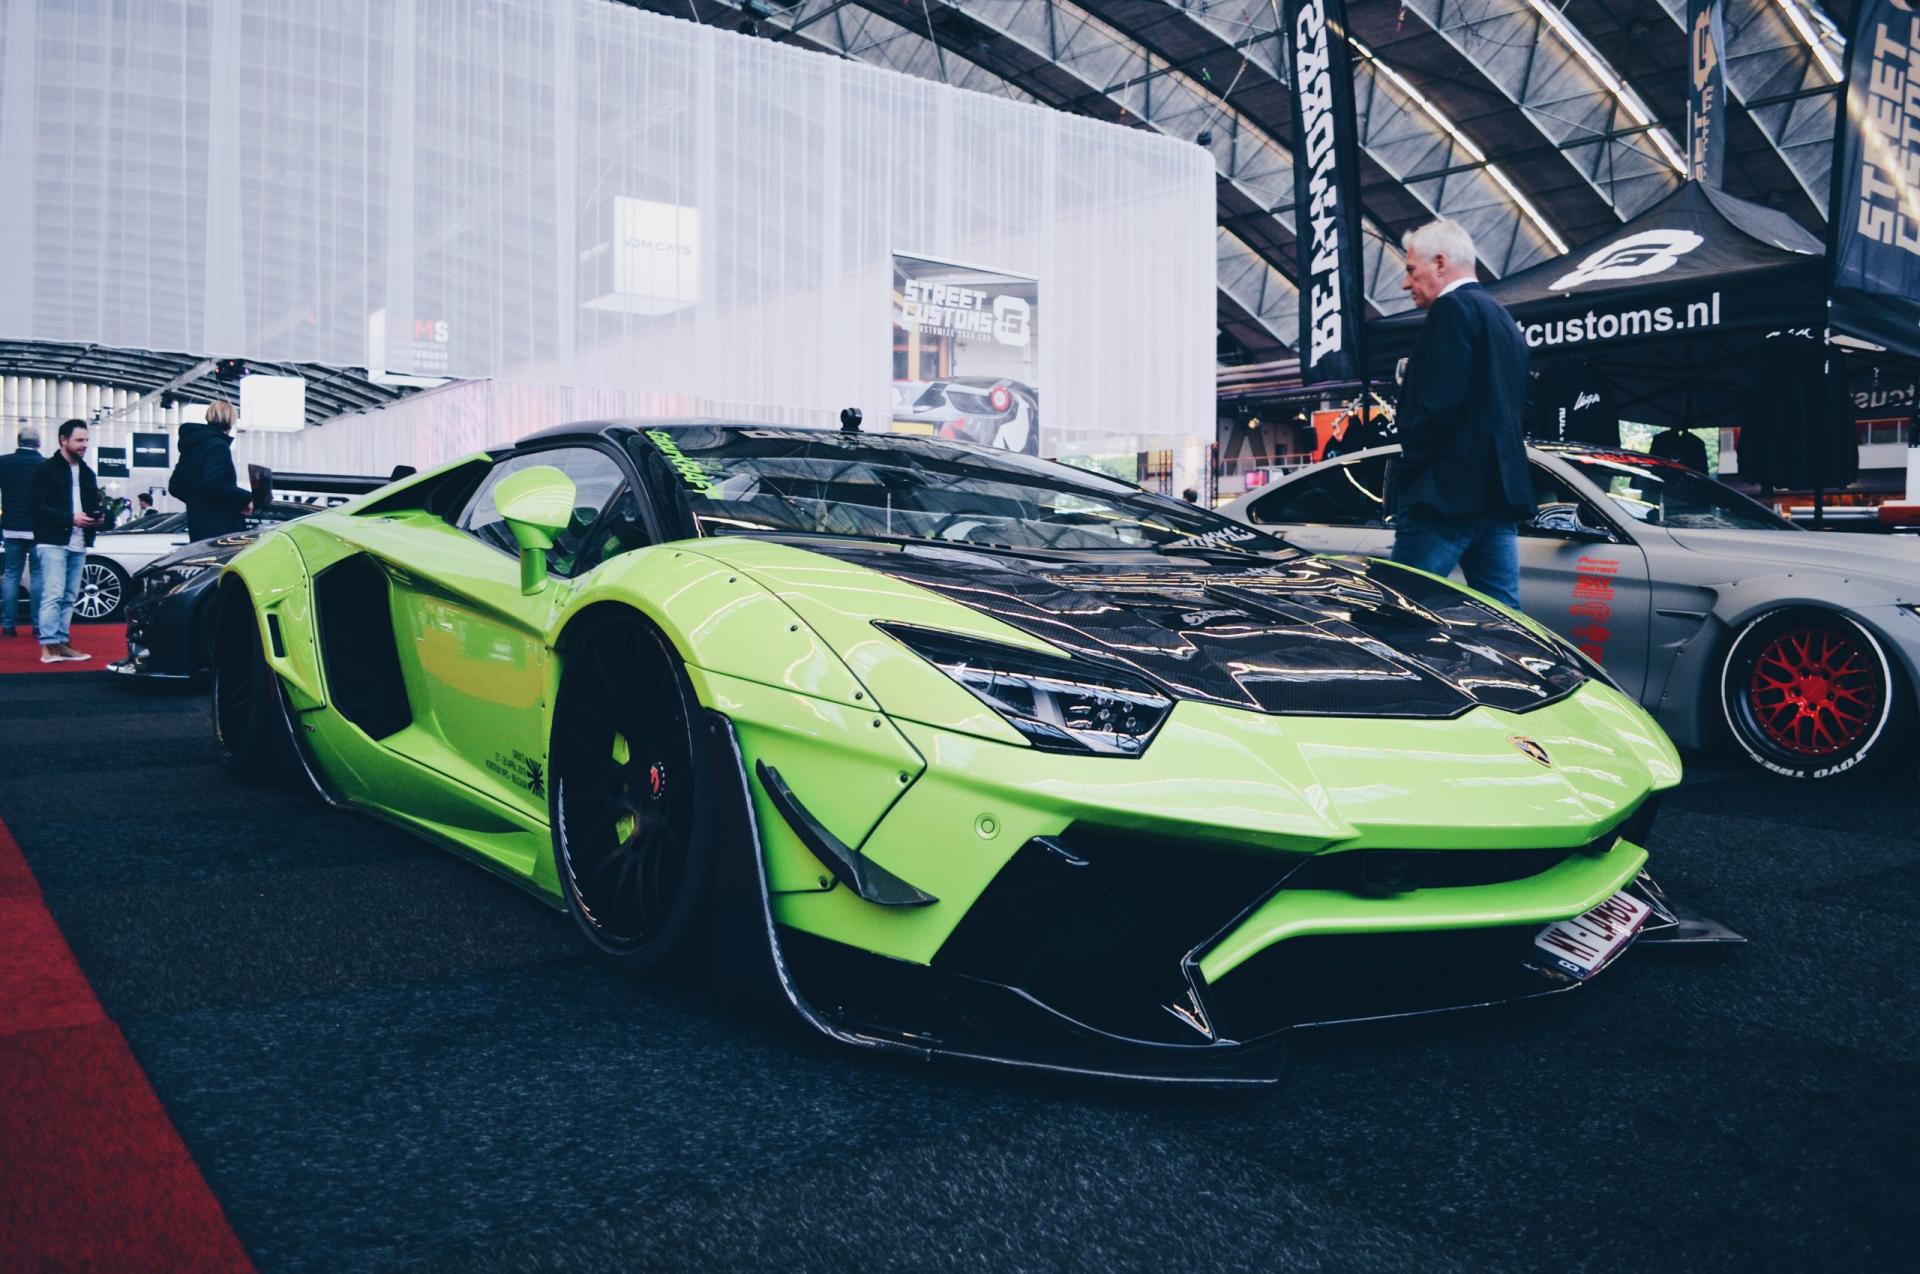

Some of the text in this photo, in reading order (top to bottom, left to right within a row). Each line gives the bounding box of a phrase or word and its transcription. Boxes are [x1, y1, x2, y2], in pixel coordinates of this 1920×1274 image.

[1858, 23, 1907, 245] STREET
[904, 279, 987, 311] STREET
[901, 301, 994, 334] CUSTOMS
[1814, 751, 1866, 778] TOYO
